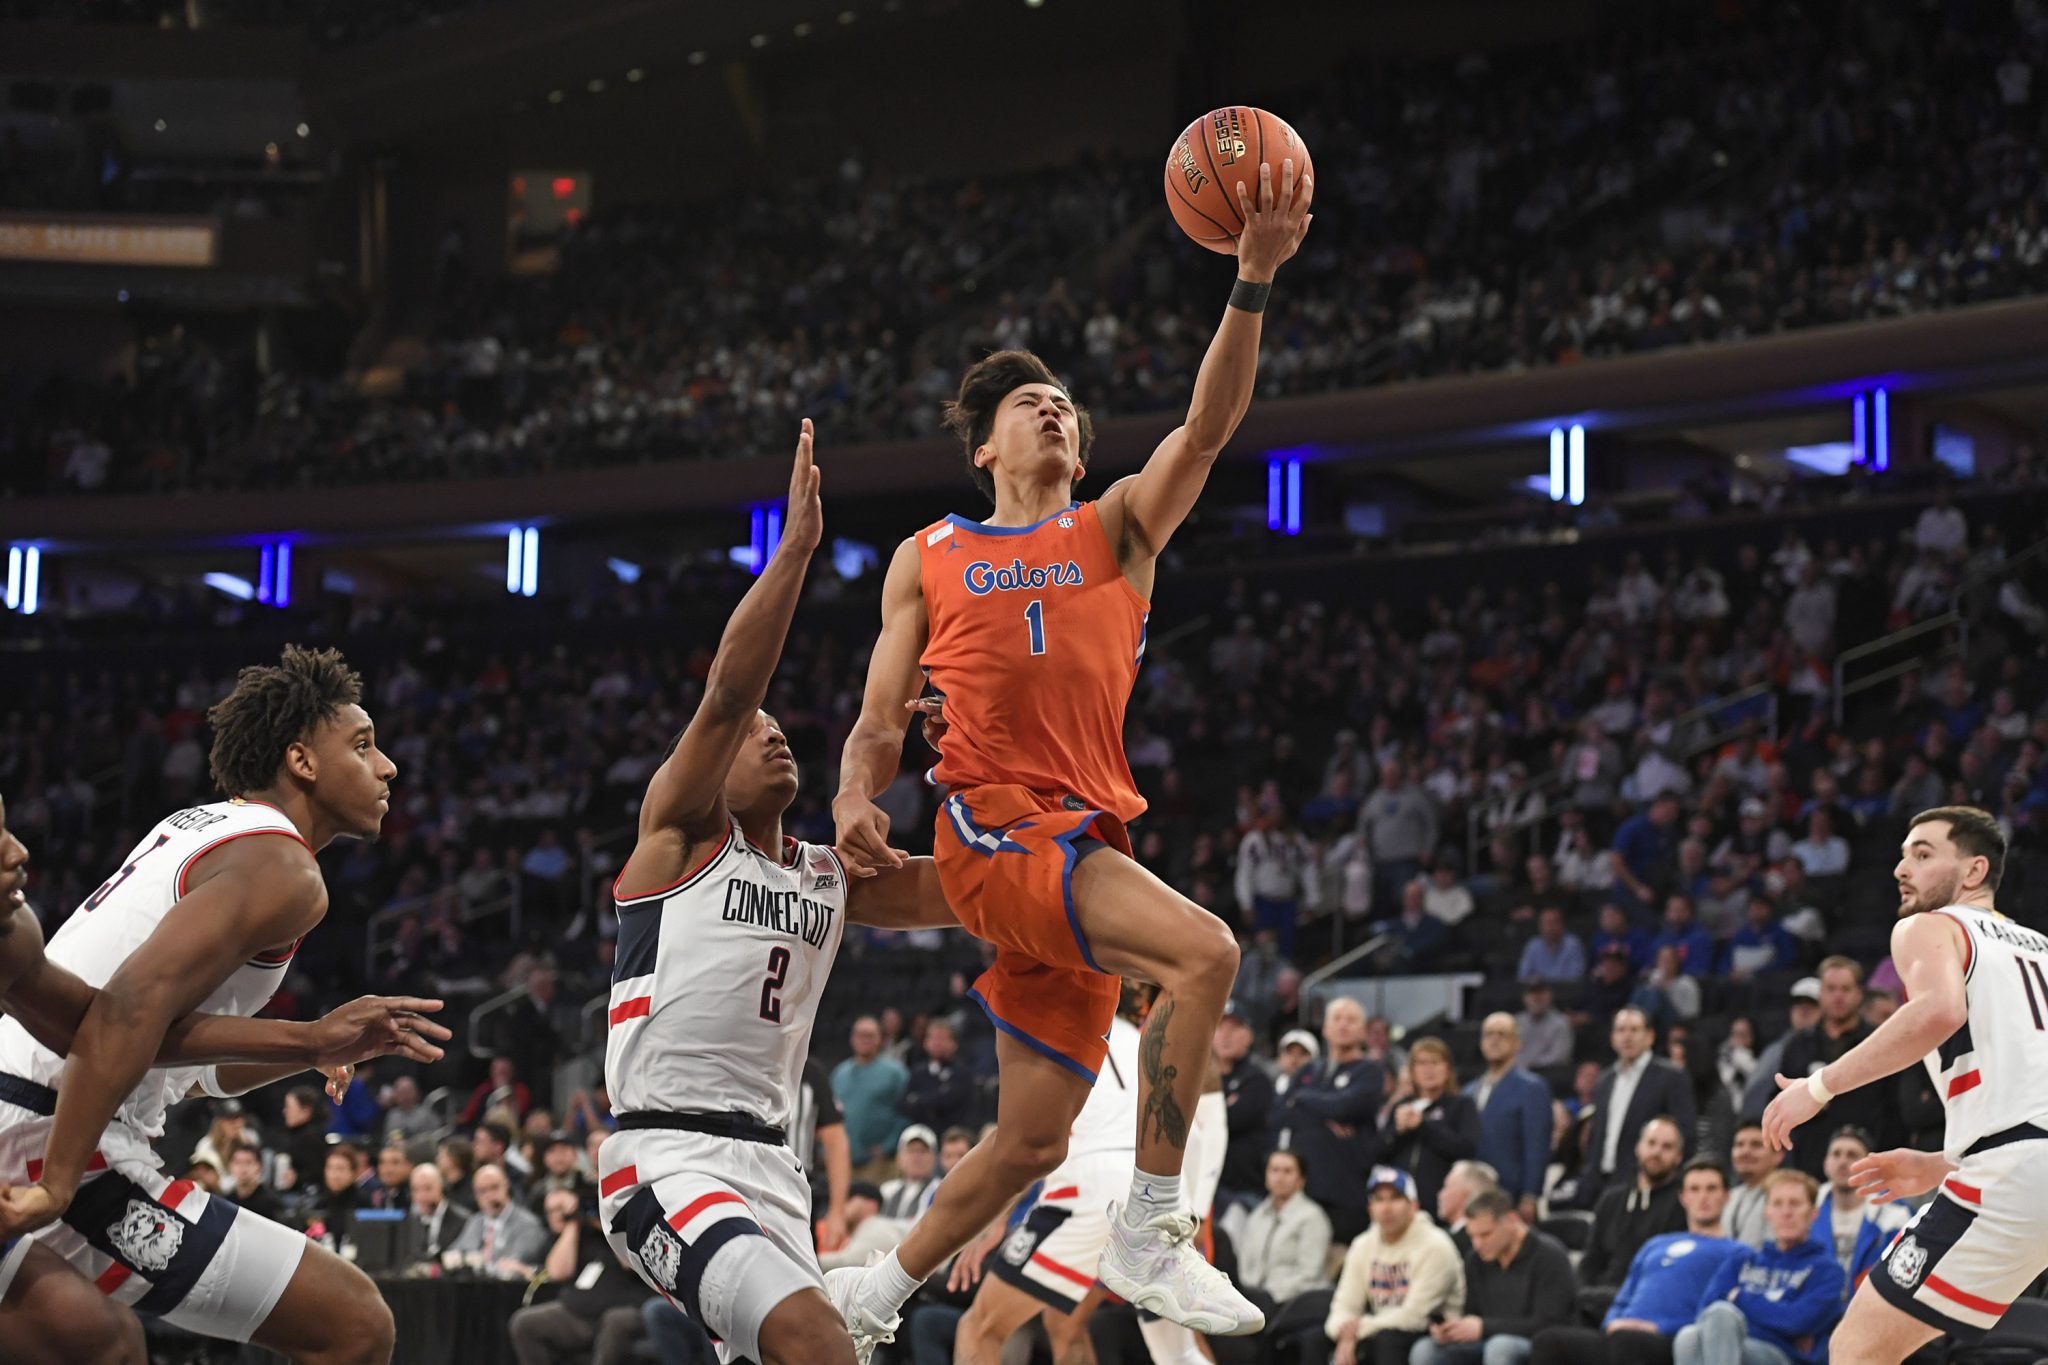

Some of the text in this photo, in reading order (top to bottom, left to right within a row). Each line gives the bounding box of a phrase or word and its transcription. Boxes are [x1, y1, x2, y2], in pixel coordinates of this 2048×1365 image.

[1177, 131, 1209, 195] SPAL
[1057, 517, 1075, 529] SEC
[963, 558, 1084, 596] Gators
[1024, 600, 1046, 656] 1
[84, 833, 172, 913] 5
[814, 880, 839, 888] EAST
[722, 878, 835, 950] CONNECCUT
[760, 946, 791, 1024] 2
